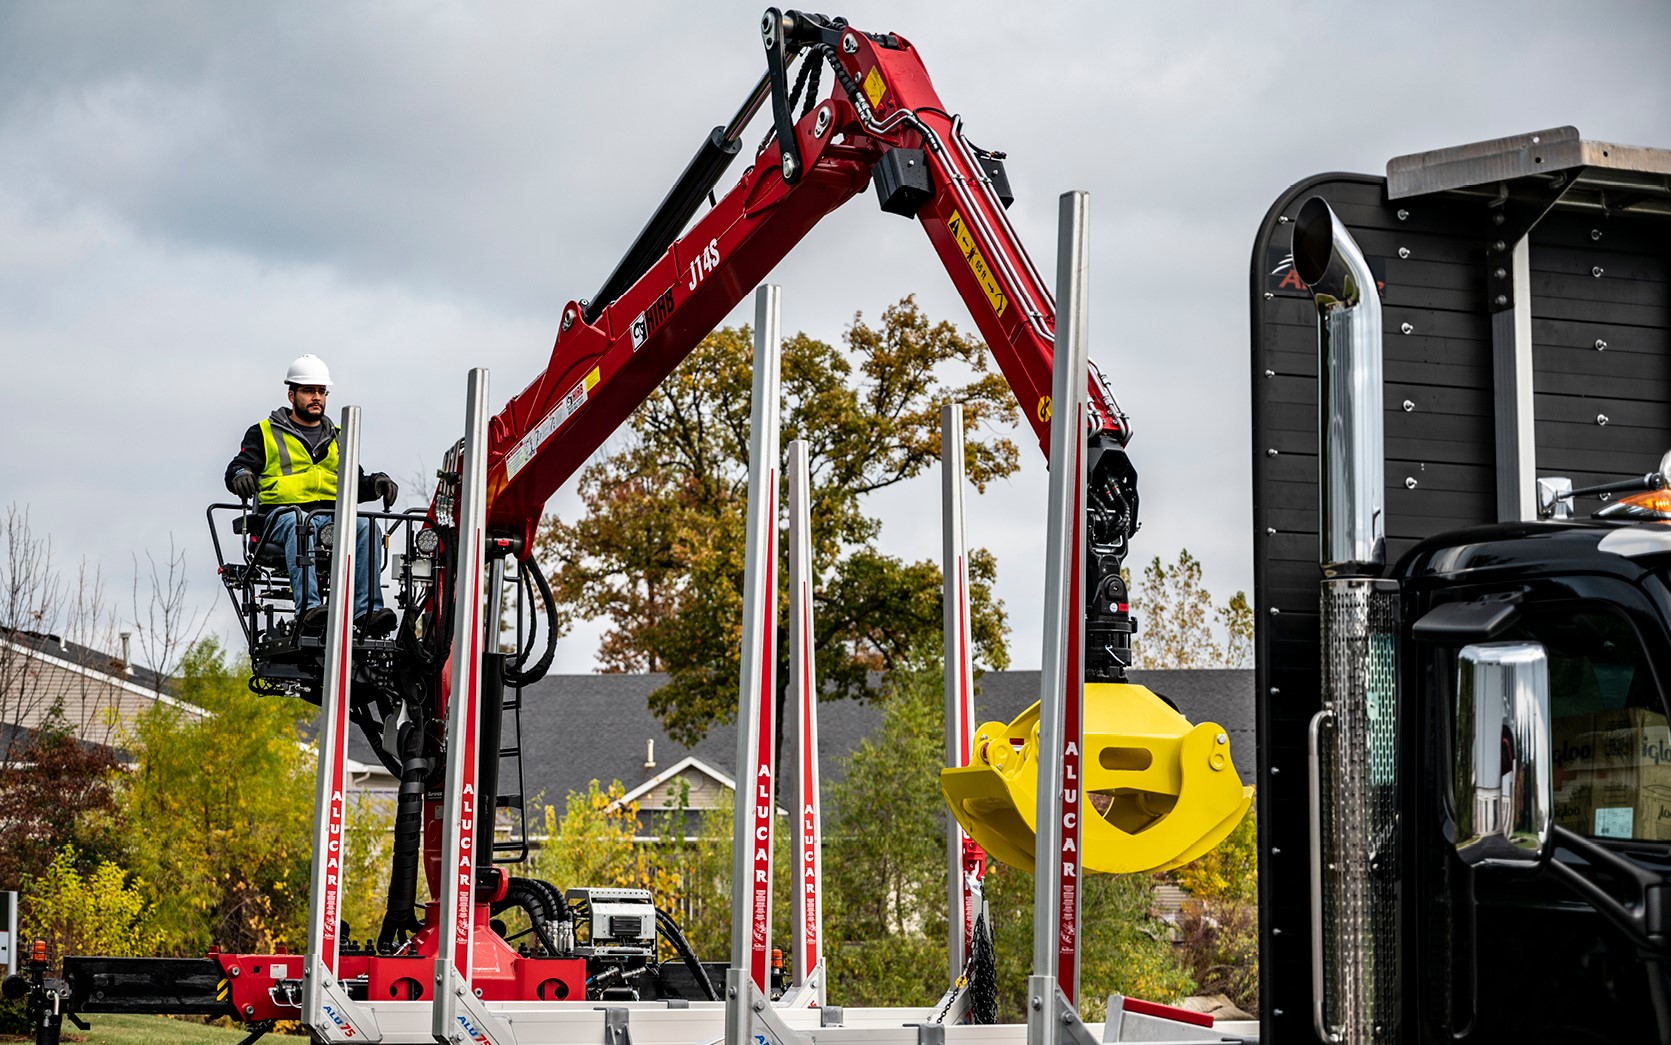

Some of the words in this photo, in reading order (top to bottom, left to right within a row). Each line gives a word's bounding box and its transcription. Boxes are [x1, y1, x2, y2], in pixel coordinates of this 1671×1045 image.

[689, 238, 720, 291] J14S
[975, 260, 983, 273] 65
[644, 287, 675, 334] HIAB
[1552, 740, 1591, 768] gloo
[1642, 735, 1671, 765] iglo
[328, 791, 342, 886] ALUCAR
[459, 783, 474, 886] ALUCAR
[755, 764, 771, 883] ALUCAR
[1062, 741, 1079, 877] ALUCAR
[804, 804, 816, 894] ALUCAR
